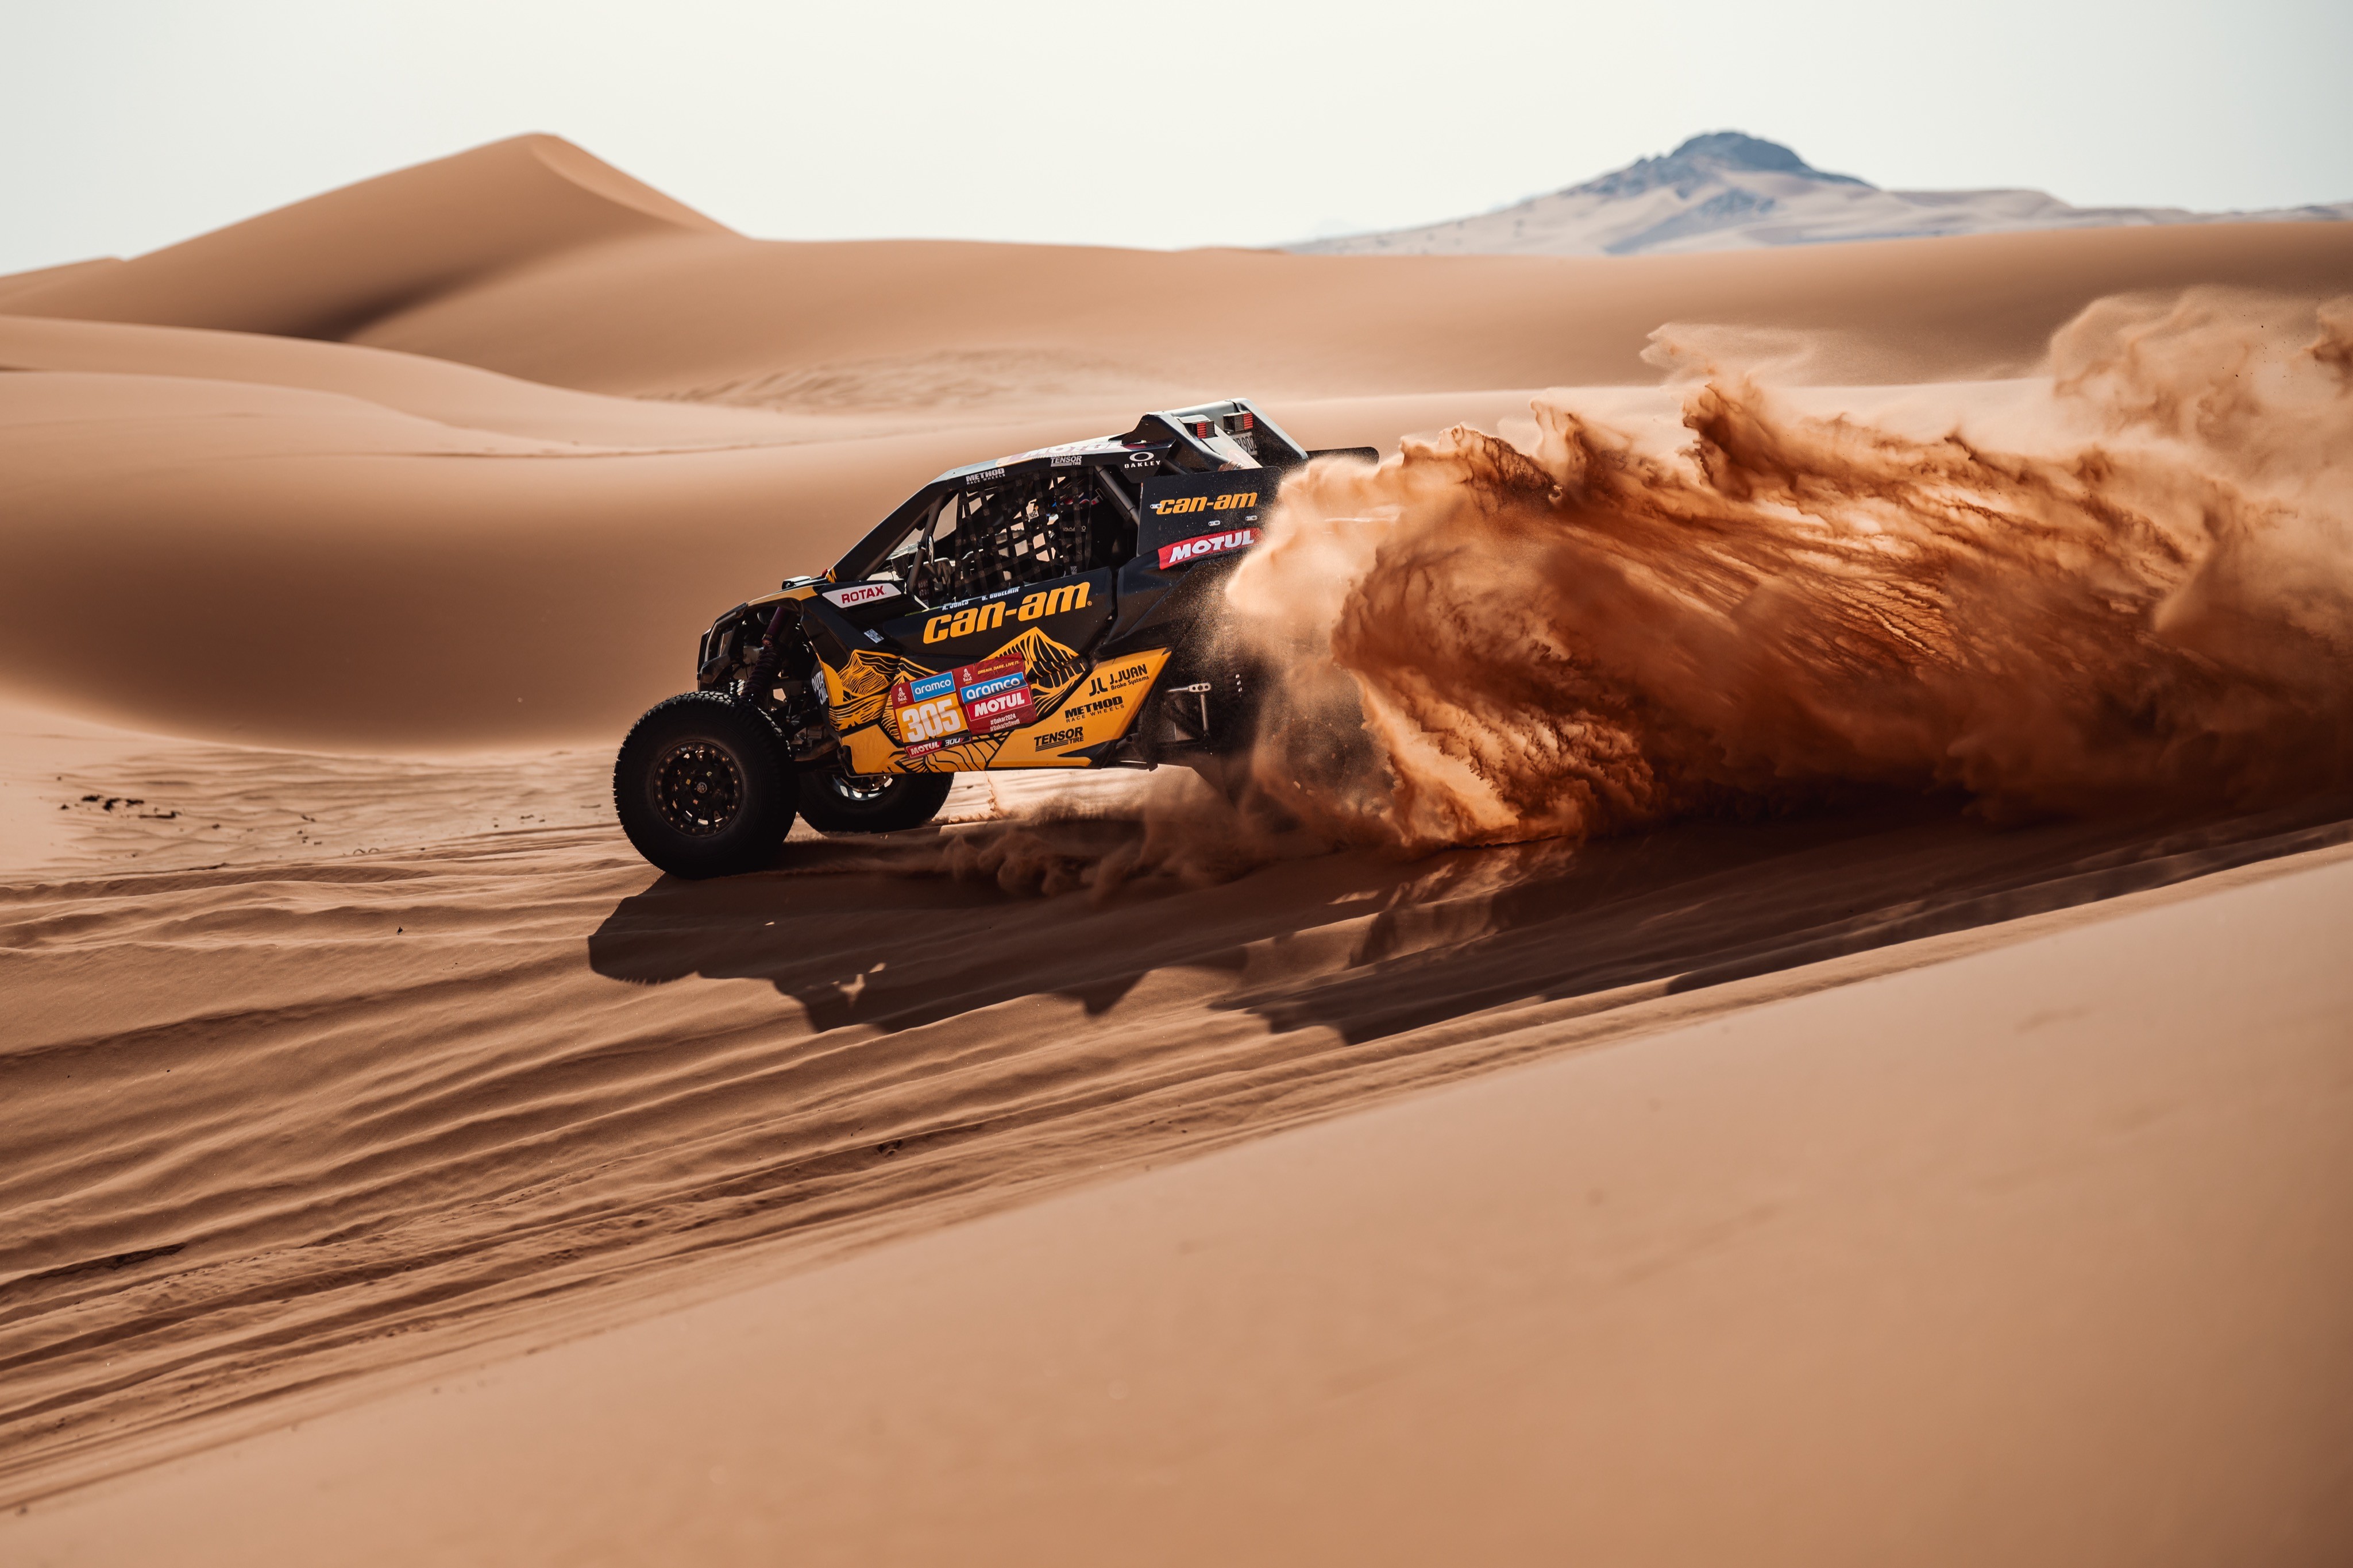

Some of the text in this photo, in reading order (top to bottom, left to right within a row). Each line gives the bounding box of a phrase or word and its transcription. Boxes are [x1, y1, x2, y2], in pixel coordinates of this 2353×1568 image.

[1051, 455, 1082, 464] TENSOR
[1124, 460, 1161, 469] OAKLEY
[966, 468, 1005, 482] METHOD
[1156, 492, 1257, 515] can-am
[1168, 530, 1255, 563] MOTUL
[841, 585, 885, 604] ROTAX
[923, 582, 1090, 644] can-am
[1110, 663, 1147, 685] J.JUAN
[1111, 675, 1149, 690] Brake Systems
[915, 679, 951, 694] aramco
[966, 677, 1021, 700] aramco
[975, 692, 1025, 717] MOTUL
[1064, 696, 1123, 719] METHOD
[1066, 704, 1124, 723] RACE WHEELS
[902, 698, 962, 743] 305
[990, 713, 1016, 725] #Dakar2024
[990, 719, 1020, 732] #DakarInSaudi
[1034, 726, 1083, 746] TENSOR
[1070, 735, 1083, 744] TIRE
[911, 741, 940, 755] MOTUL
